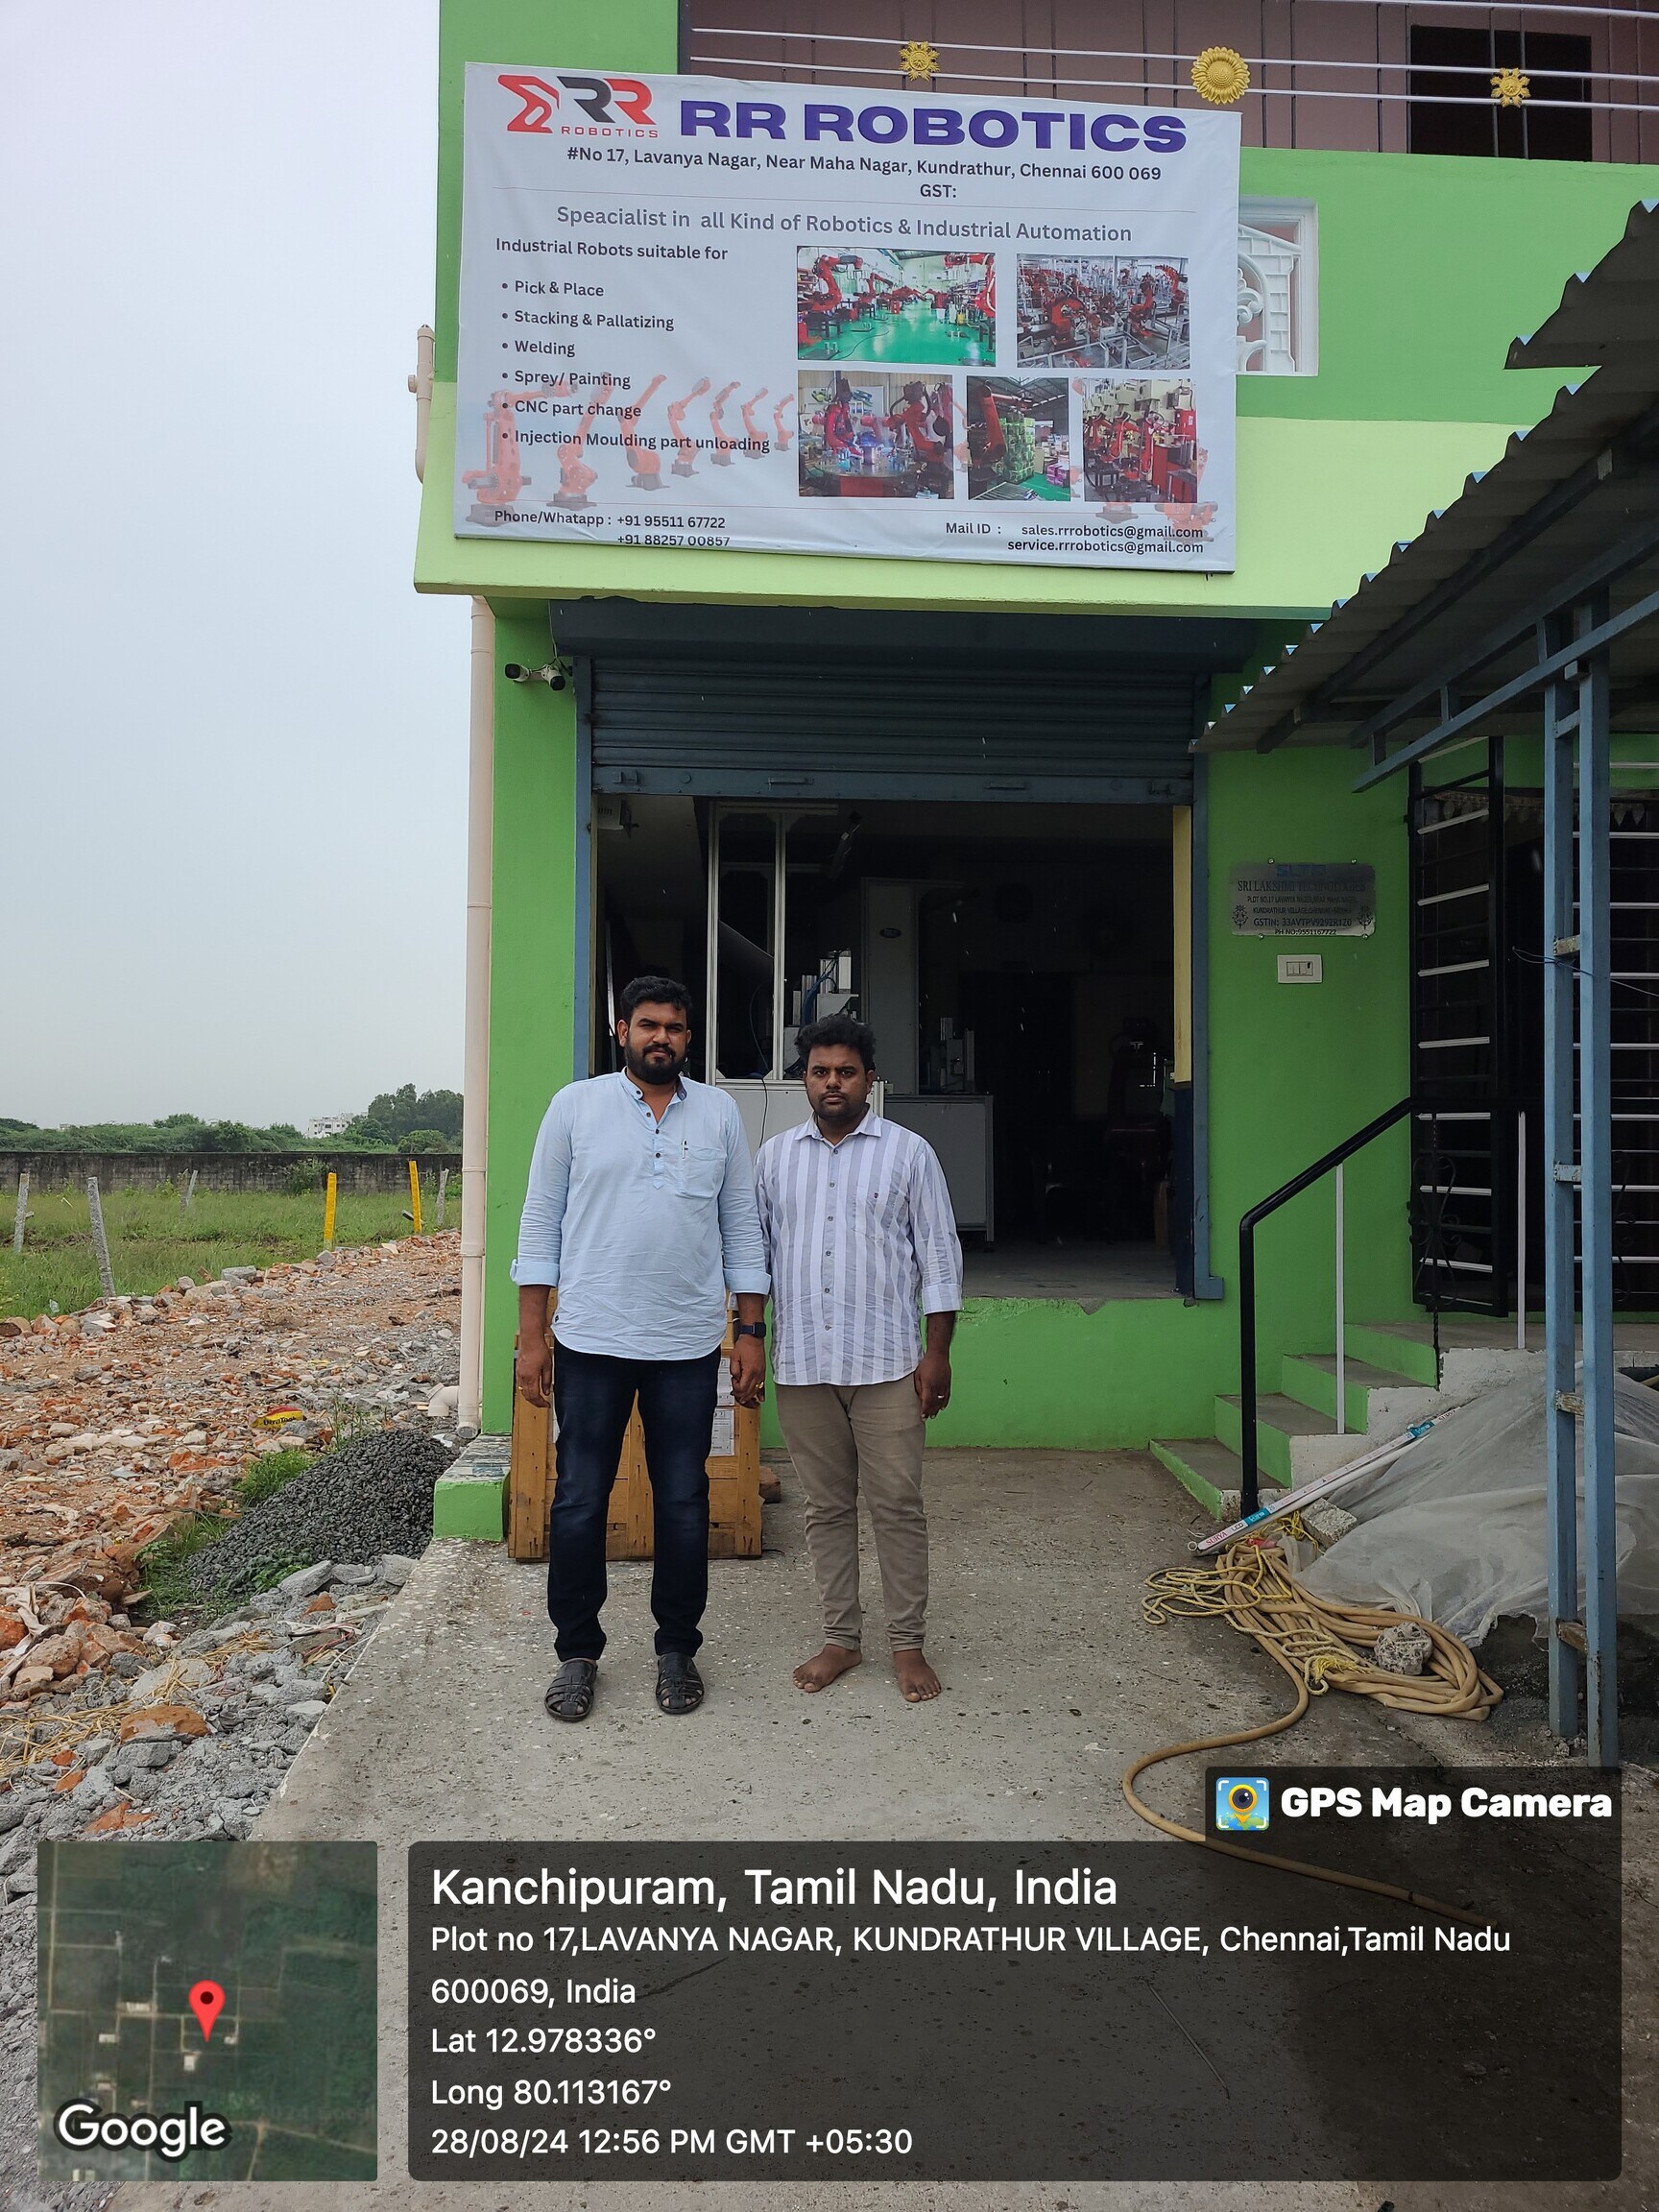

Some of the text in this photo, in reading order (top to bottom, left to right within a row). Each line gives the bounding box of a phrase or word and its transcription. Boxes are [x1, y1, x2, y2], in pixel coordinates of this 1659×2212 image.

[562, 126, 659, 138] ROBOTICS
[680, 100, 1187, 153] RR ROBOTICS
[567, 147, 1161, 180] #No 17, Lavanya Nagar, Near Maha Nagar, Kundrathur, Chennai 600 069
[921, 184, 956, 198] GST:
[558, 206, 1131, 241] Speacialist in all Kind of Robotics & Industrial Automation
[497, 238, 728, 259] Industrial Robots suitable for
[516, 280, 603, 296] Pick & Place
[516, 310, 674, 331] Stacking & Pallatizing
[515, 341, 575, 357] Welding
[516, 371, 630, 390] Sprey/ Painting
[516, 400, 640, 420] CNC part change
[516, 430, 770, 453] Injection Moulding part unloading
[495, 510, 603, 527] Phone/Whatapp
[618, 516, 640, 526] +91
[645, 516, 684, 527] 95511
[688, 517, 725, 528] 67722
[947, 523, 974, 533] Mail
[977, 524, 990, 534] ID
[1022, 524, 1203, 540] sales.rrrobotics@gmail.com
[618, 535, 730, 546] +91 88257 00857
[1008, 539, 1204, 554] service.rrrobotics@gmail.com
[1238, 880, 1252, 892] SRI
[1253, 918, 1279, 927] GSTIN:
[1206, 1531, 1228, 1545] SURYA
